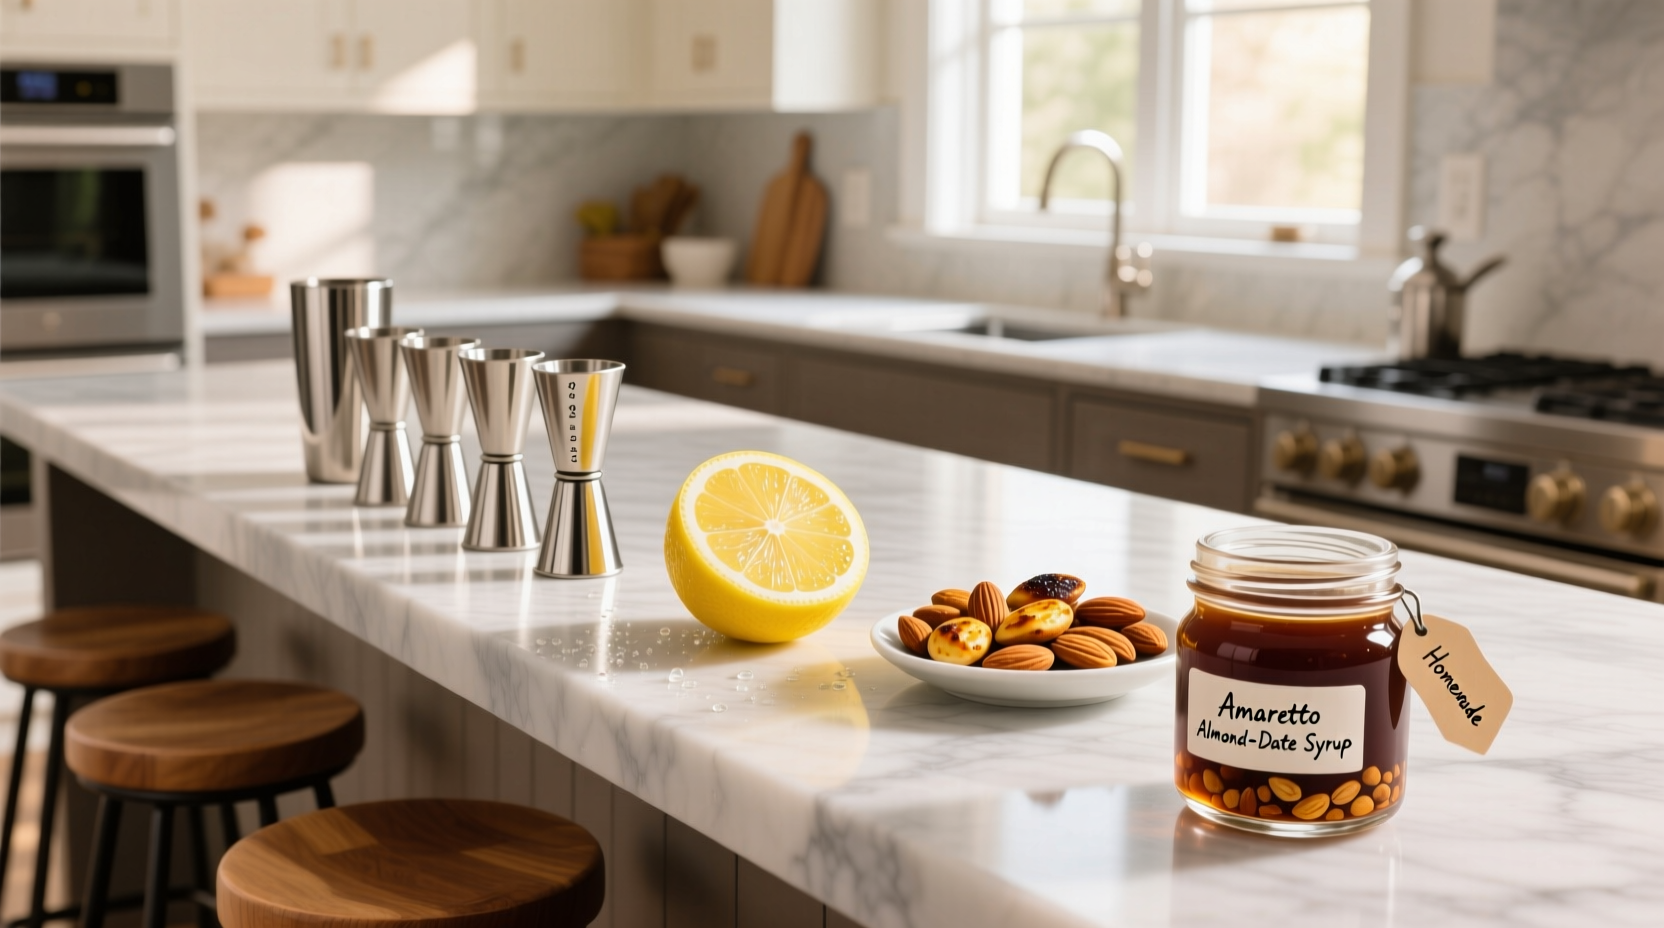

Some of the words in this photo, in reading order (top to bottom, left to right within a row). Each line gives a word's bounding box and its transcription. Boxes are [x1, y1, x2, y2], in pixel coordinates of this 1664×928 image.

[1218, 691, 1321, 725] Amaretto
[1196, 719, 1297, 752] Almond-Date
[1303, 732, 1353, 761] Syrup
